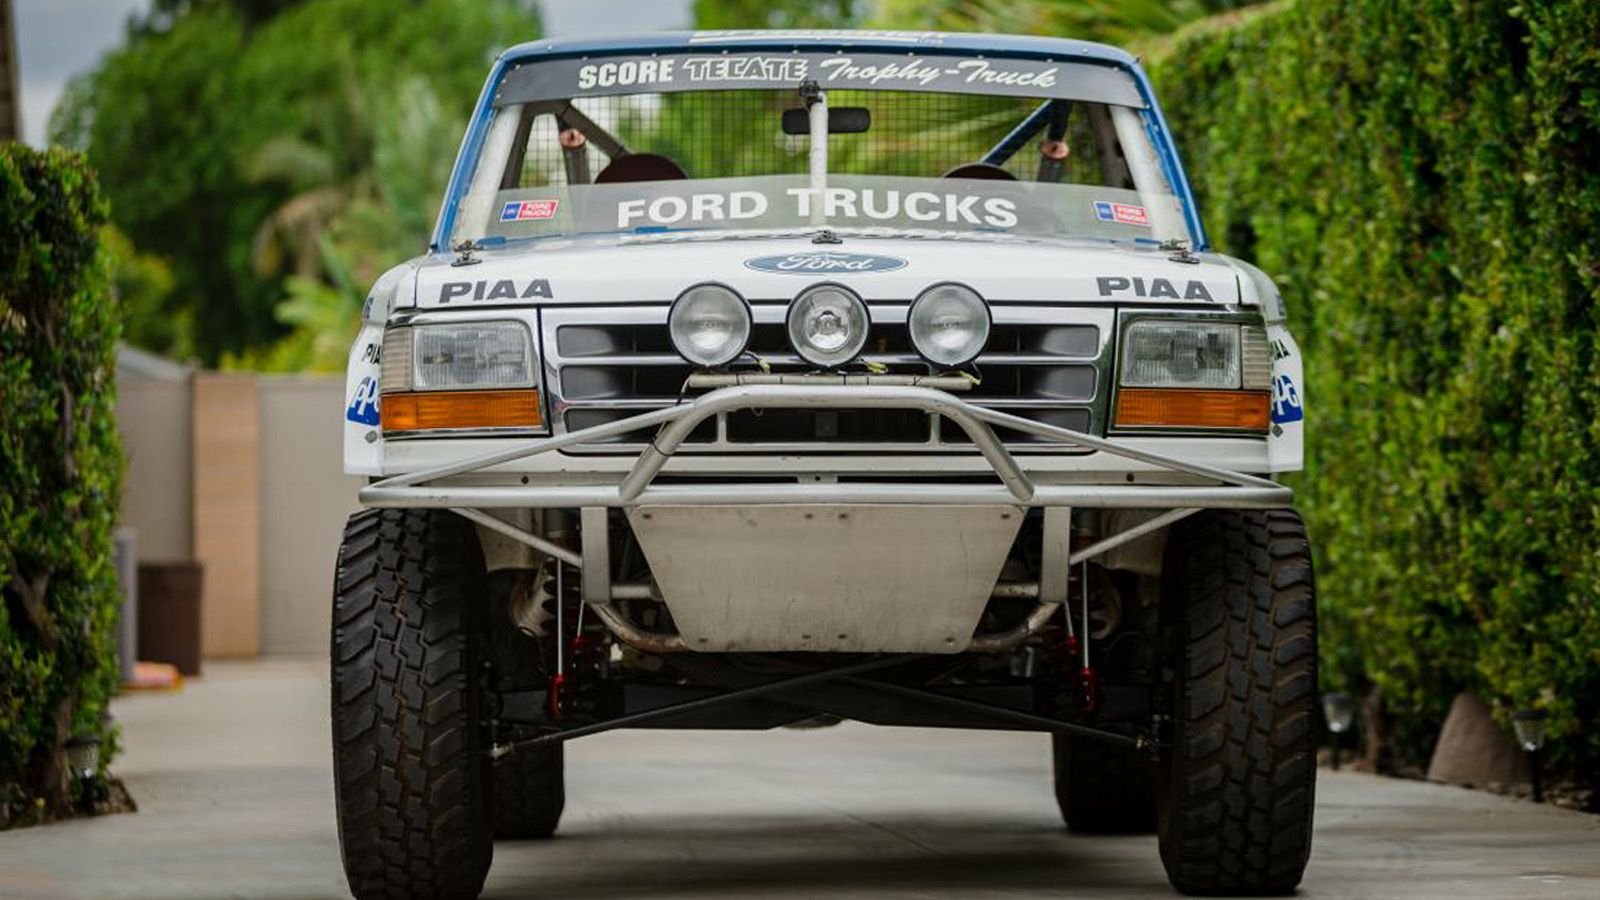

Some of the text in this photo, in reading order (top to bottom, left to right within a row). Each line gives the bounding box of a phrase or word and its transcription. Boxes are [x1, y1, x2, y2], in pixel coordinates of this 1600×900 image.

[578, 57, 1059, 89] SCORE TECATE Trophy-Truck
[617, 188, 1018, 228] FORD TRUCKS
[776, 253, 875, 270] Ford
[439, 278, 553, 303] PIAA
[1096, 276, 1214, 302] PIAA
